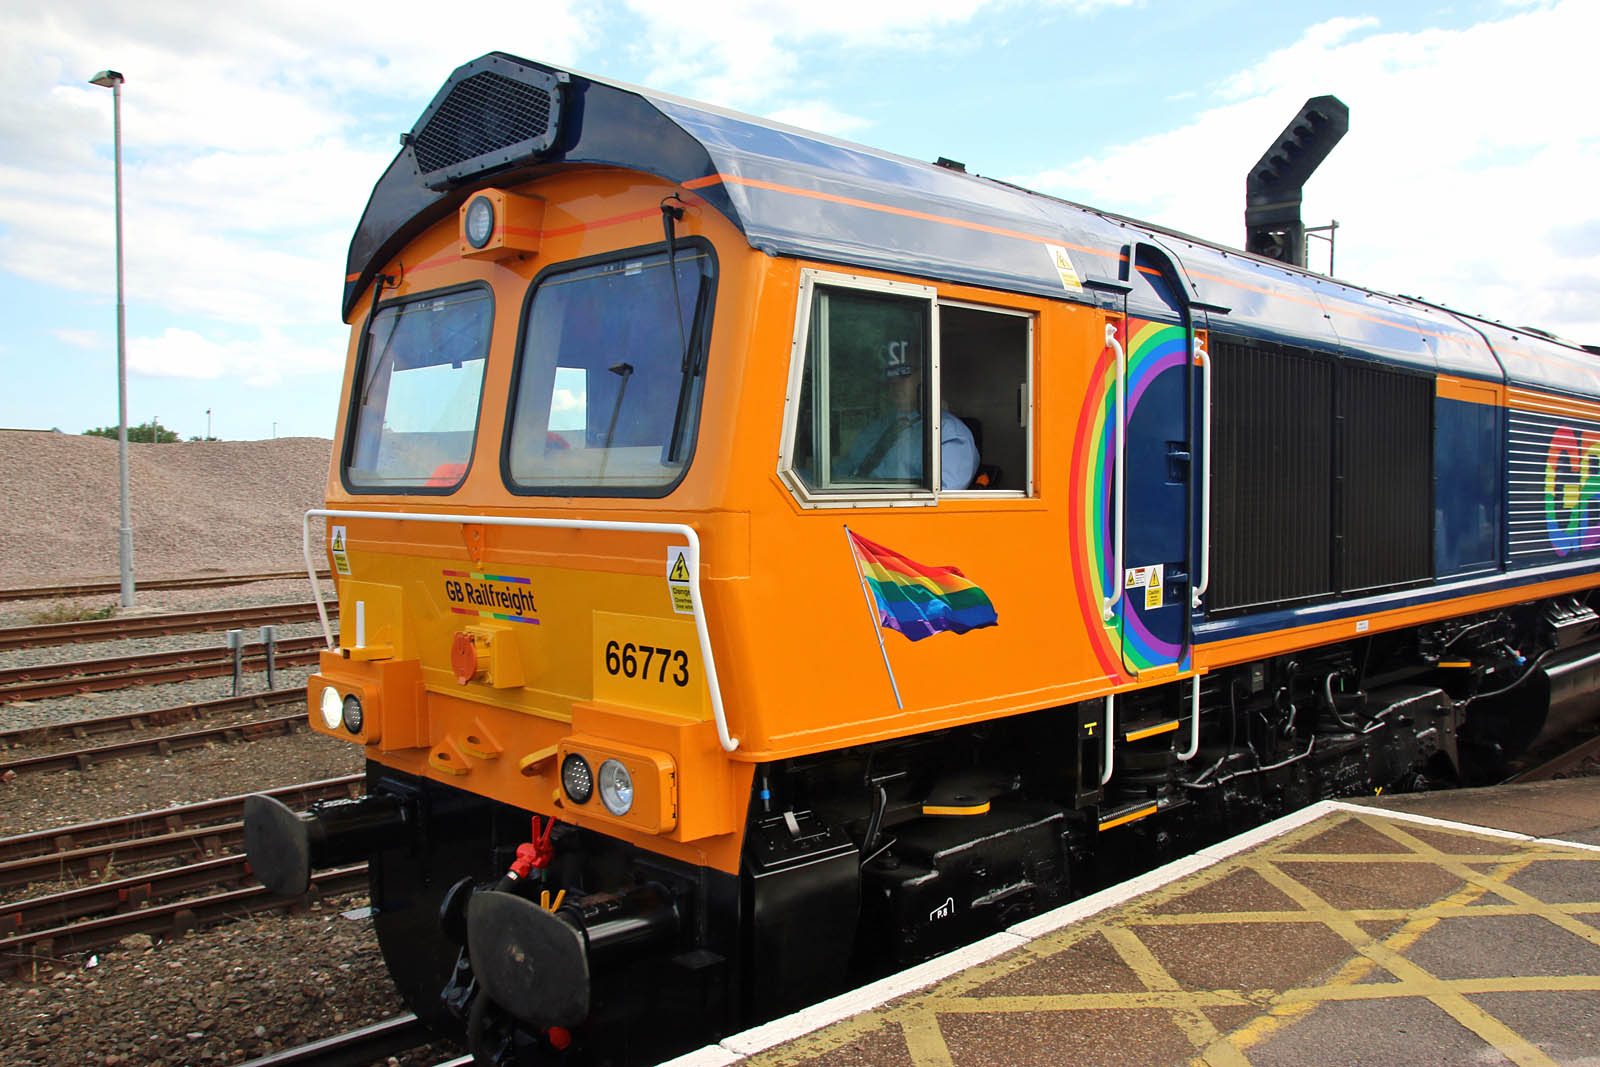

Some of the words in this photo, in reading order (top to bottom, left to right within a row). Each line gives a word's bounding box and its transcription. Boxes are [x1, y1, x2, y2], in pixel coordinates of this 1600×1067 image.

[446, 580, 465, 602] GB
[465, 582, 537, 616] Railfreight
[605, 640, 689, 688] 66773
